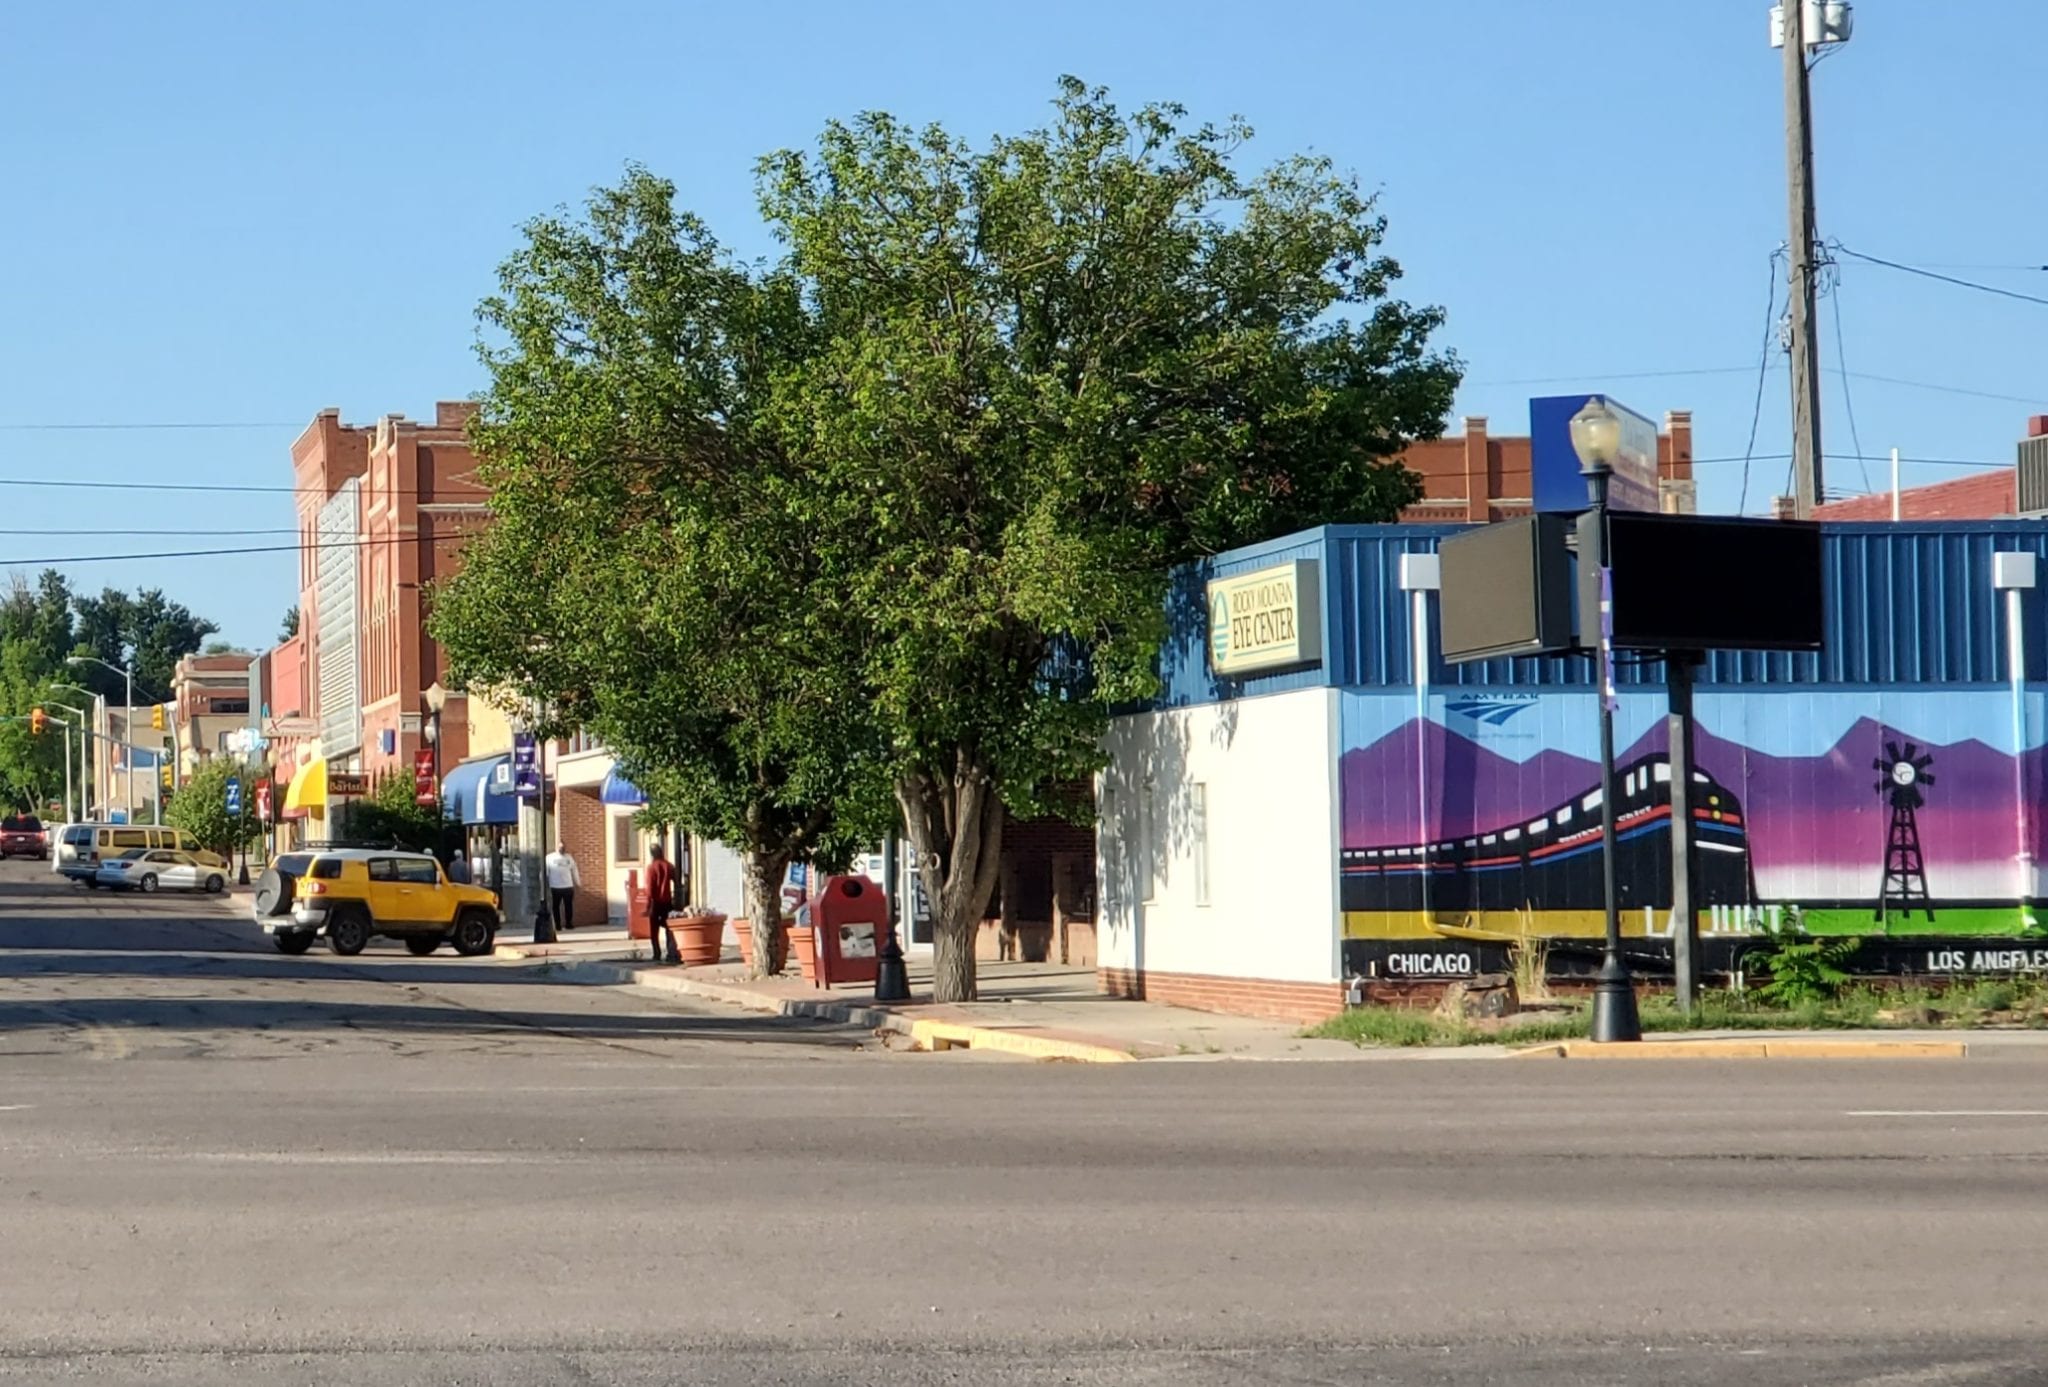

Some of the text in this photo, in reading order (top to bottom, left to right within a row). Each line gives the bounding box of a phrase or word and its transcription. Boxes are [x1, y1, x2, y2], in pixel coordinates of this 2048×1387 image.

[1232, 581, 1294, 614] ROCKY MOUNTAIN
[1232, 606, 1296, 650] EYE CENTER
[1388, 953, 1471, 974] CHICAGO
[1927, 951, 1966, 971] LOS
